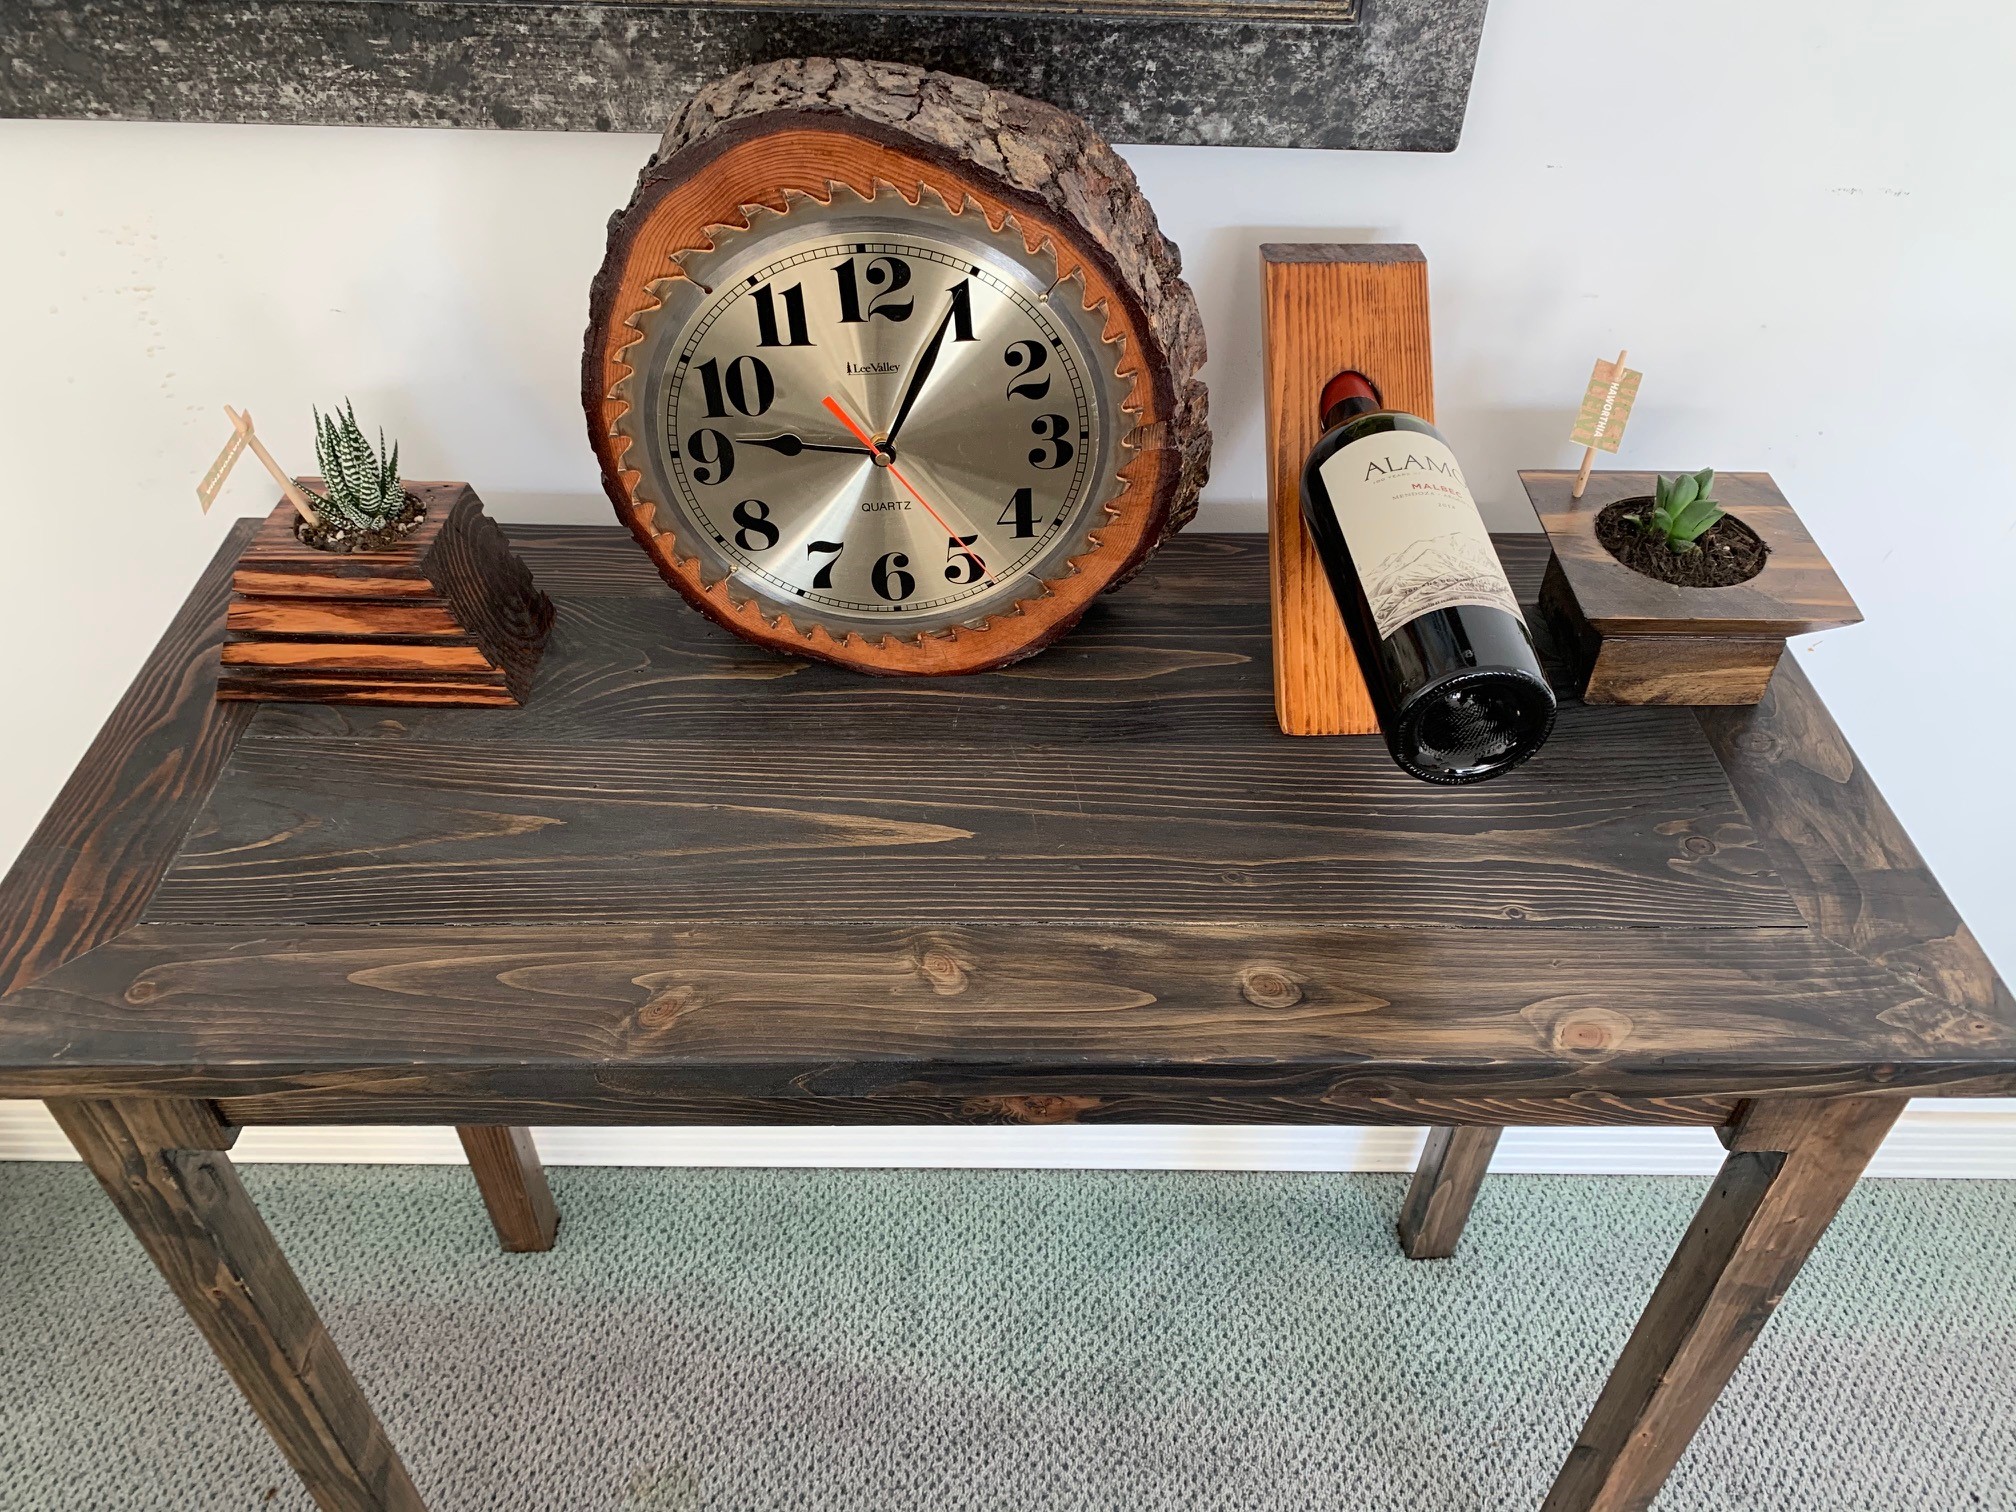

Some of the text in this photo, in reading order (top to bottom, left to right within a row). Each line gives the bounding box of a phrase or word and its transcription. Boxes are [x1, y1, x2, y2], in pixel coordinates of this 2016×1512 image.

[747, 281, 817, 348] 11
[830, 256, 915, 323] 12
[945, 277, 982, 343] 1
[693, 355, 775, 419] 10
[1004, 339, 1051, 402] 2
[1593, 381, 1620, 438] HAWORTHIA
[687, 427, 735, 486] 9
[1027, 413, 1075, 471] 3
[860, 500, 912, 513] QUARTZ
[996, 487, 1044, 540] 4
[1392, 491, 1435, 501] MENDOZA
[1411, 483, 1463, 499] MALBEC
[732, 498, 780, 552] 8
[806, 539, 845, 590] 7
[870, 551, 916, 602] 6
[943, 534, 987, 585] 5
